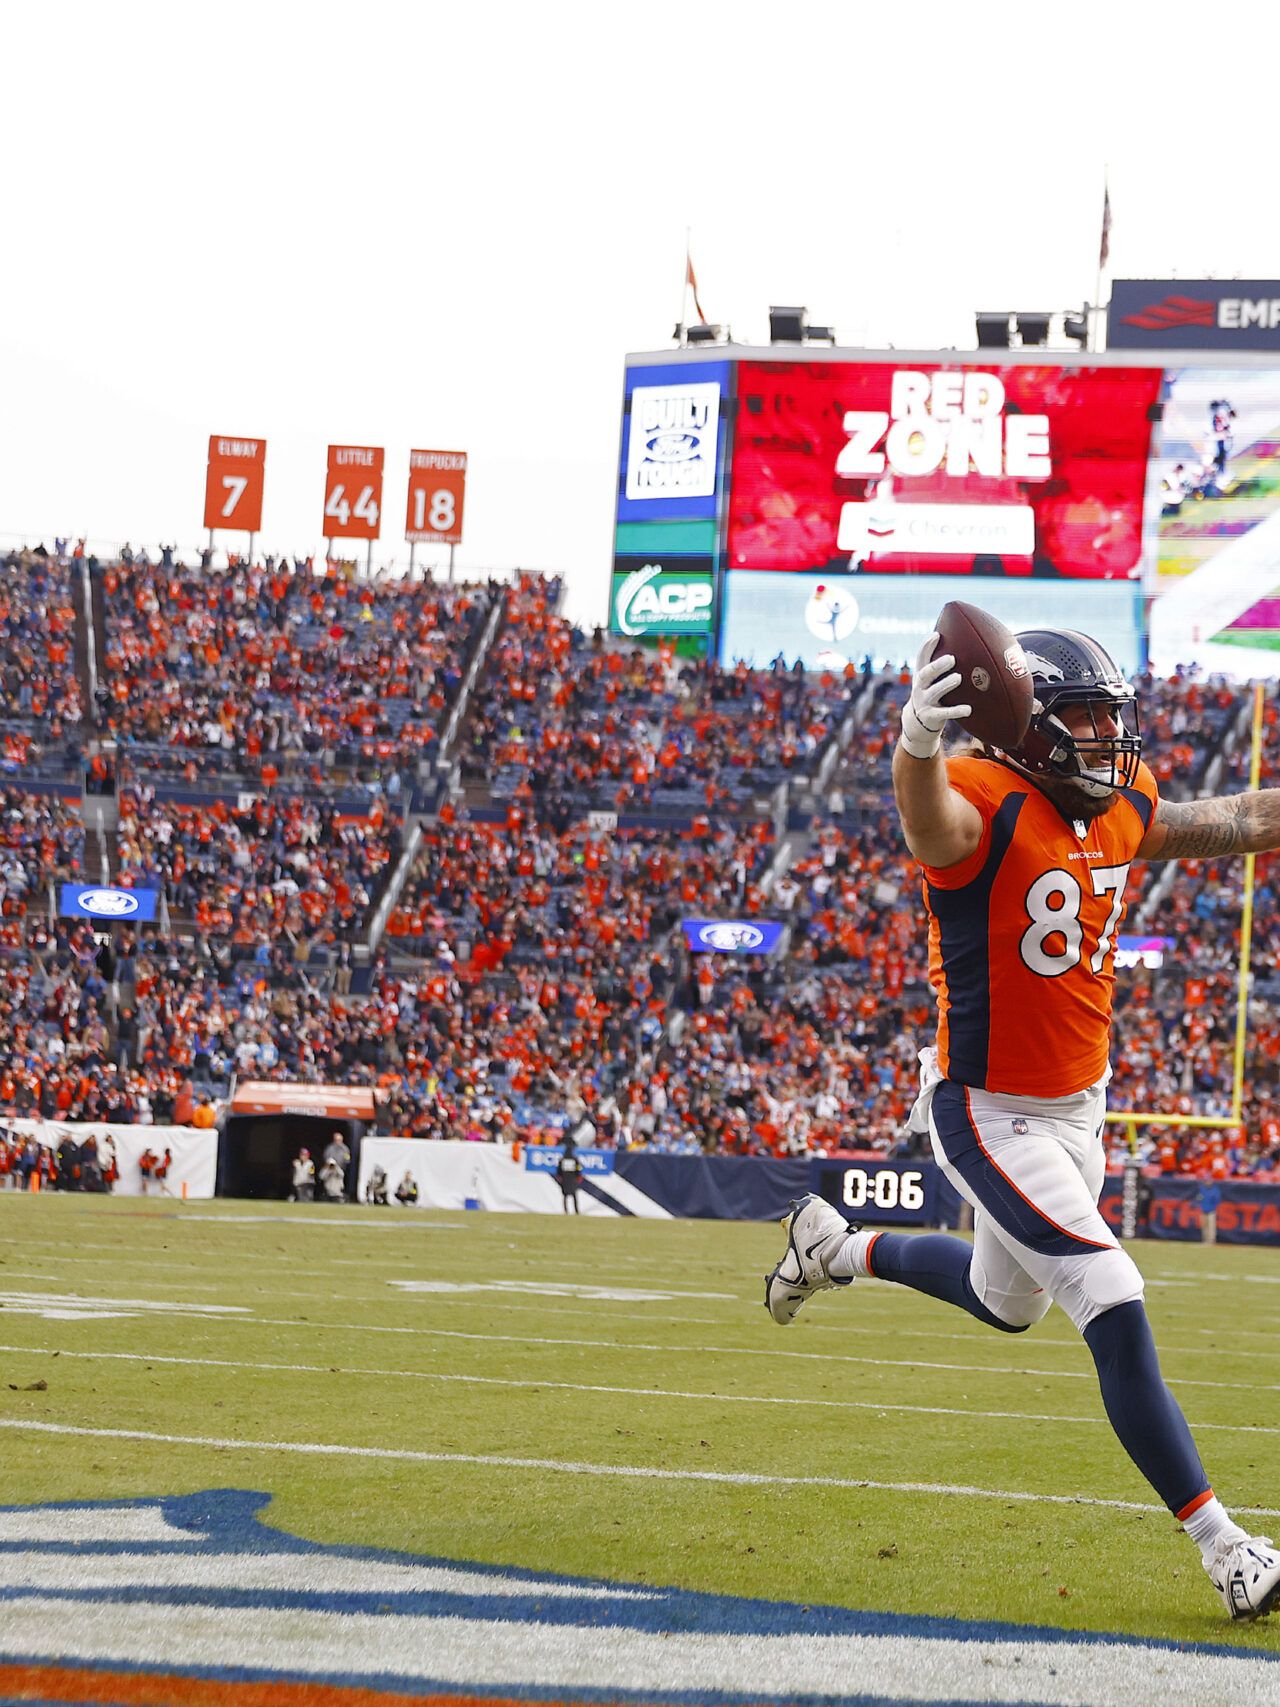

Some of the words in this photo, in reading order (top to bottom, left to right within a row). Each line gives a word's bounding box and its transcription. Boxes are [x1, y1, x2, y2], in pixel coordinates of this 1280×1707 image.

[643, 397, 710, 430] BUILT
[891, 371, 1005, 420] RED
[336, 448, 374, 467] LITTLE
[835, 411, 1052, 481] ZONE
[222, 476, 248, 517] 7
[325, 484, 379, 527] 44
[414, 488, 455, 531] 18
[908, 519, 1007, 537] Chevron
[631, 583, 712, 614] ACP
[1019, 861, 1131, 978] 87
[843, 1169, 924, 1210] 0:06
